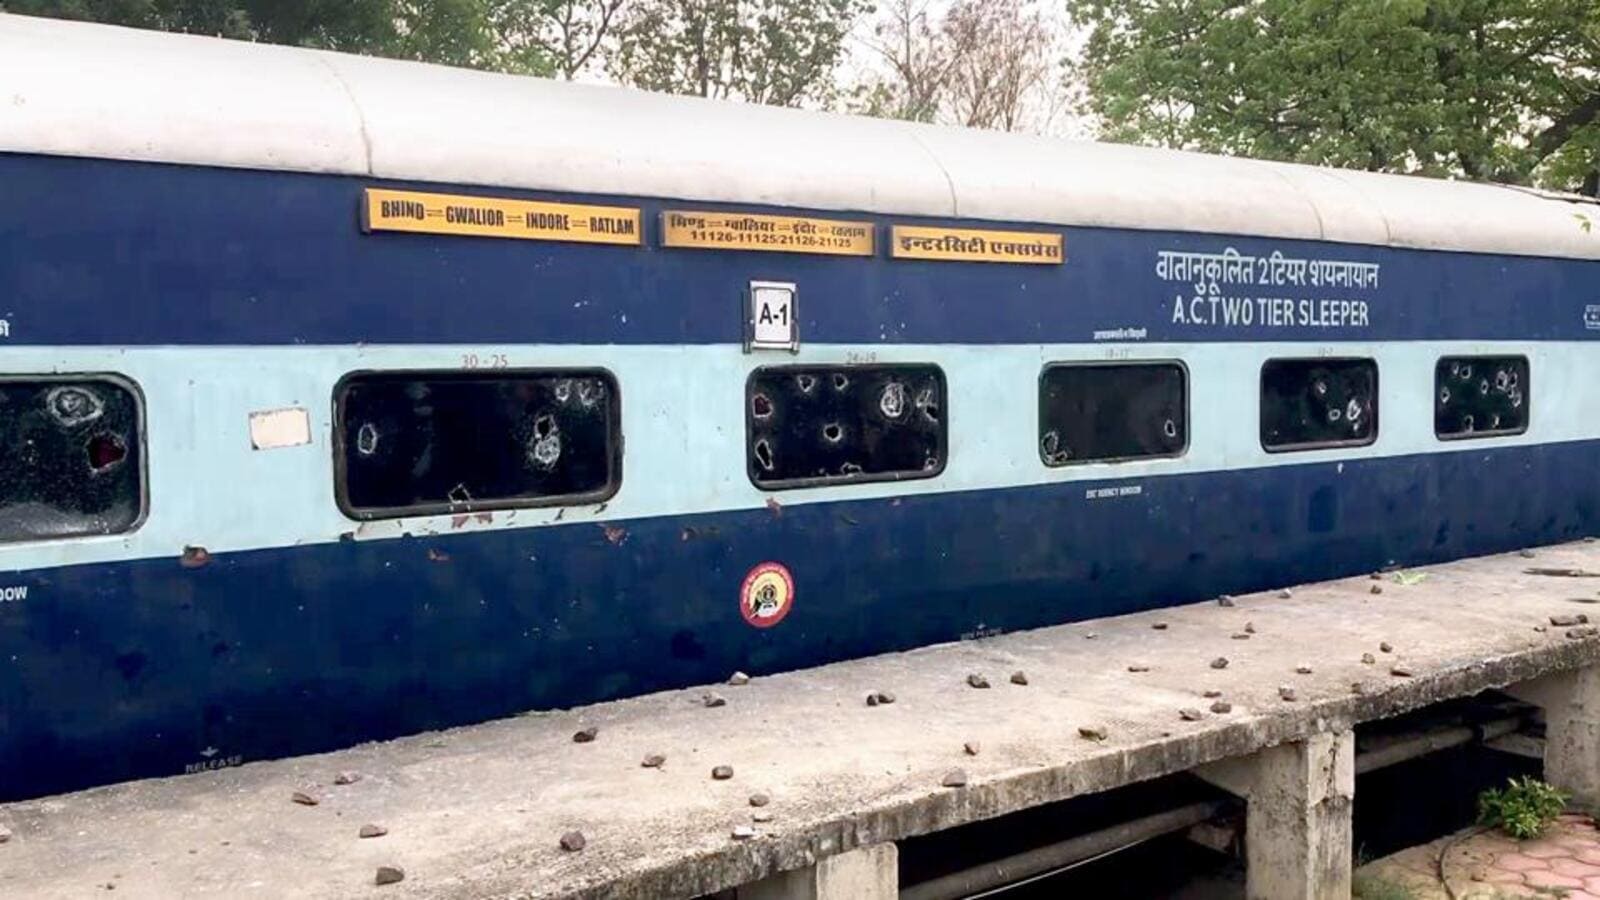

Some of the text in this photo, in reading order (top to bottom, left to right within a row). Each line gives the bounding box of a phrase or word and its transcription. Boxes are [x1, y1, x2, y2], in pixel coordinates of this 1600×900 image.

[381, 201, 634, 234] BHIND GWALIOR INDORE RATLAM
[1156, 247, 1256, 295] वातानुकूलित
[759, 302, 788, 326] A-1
[1257, 297, 1295, 326] TIER
[1298, 300, 1370, 327] SLEEPER
